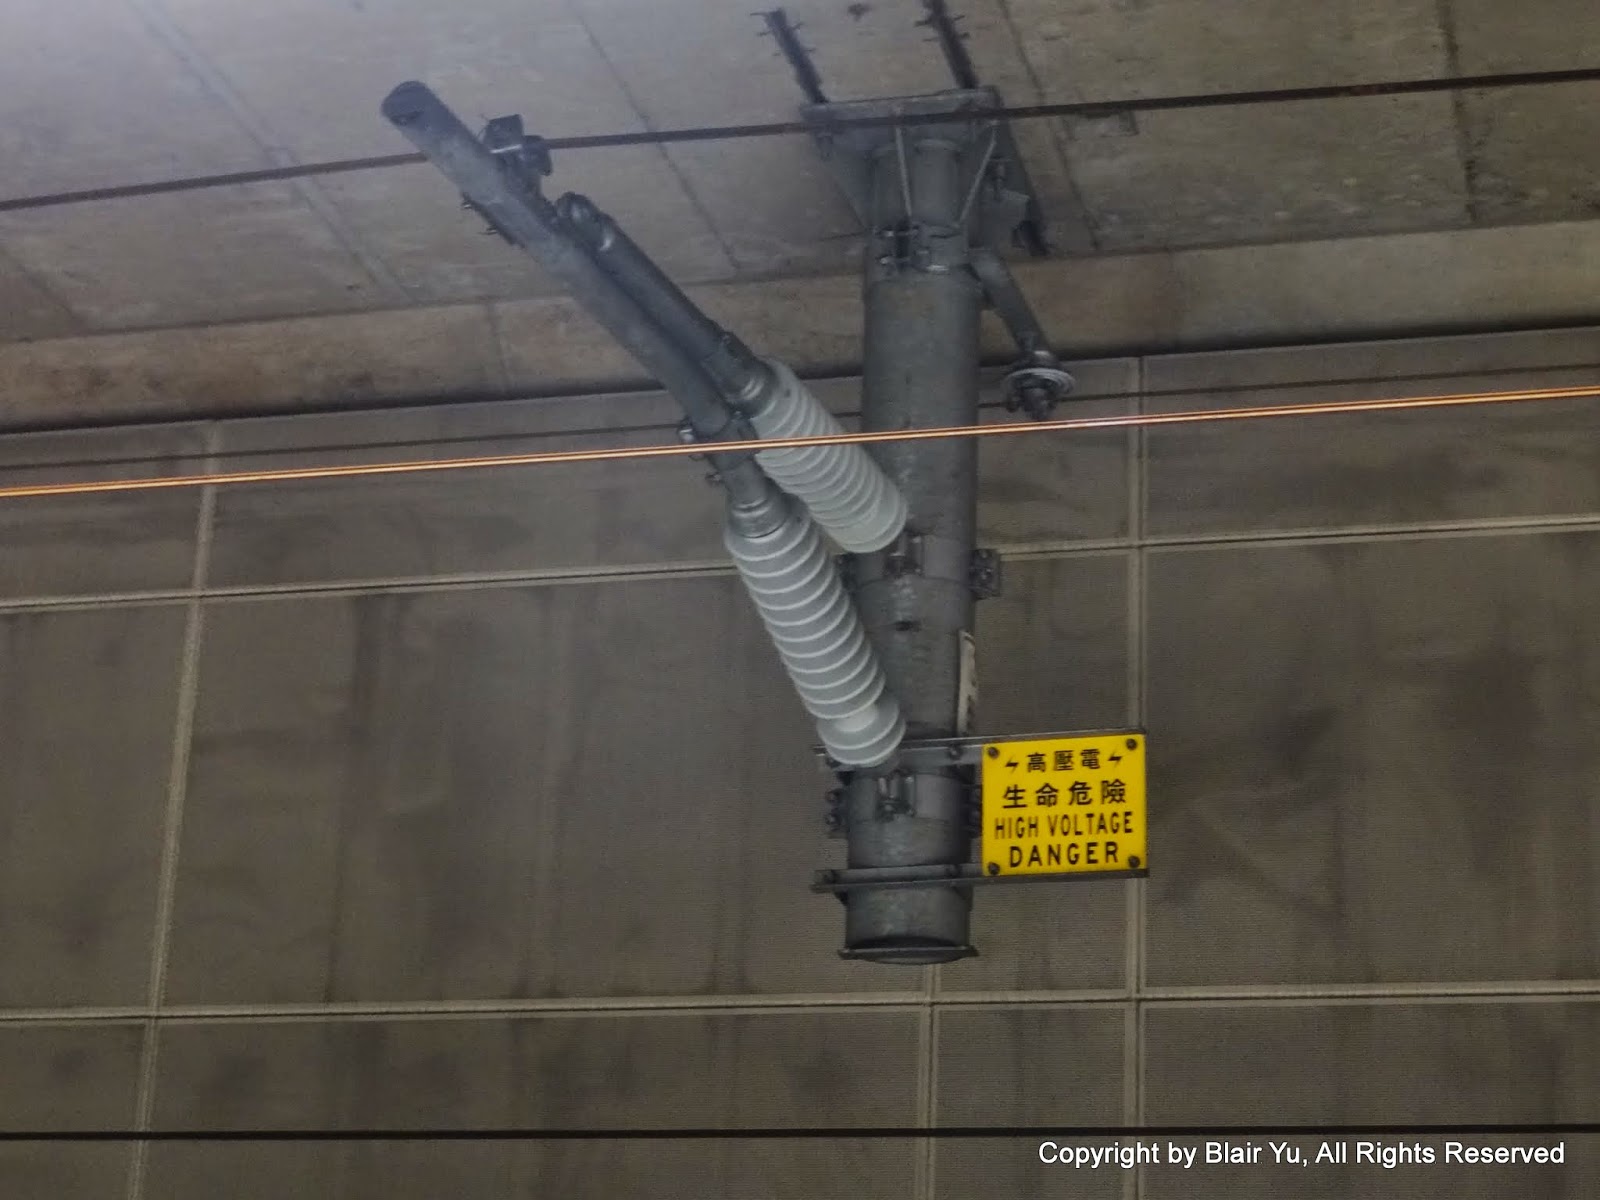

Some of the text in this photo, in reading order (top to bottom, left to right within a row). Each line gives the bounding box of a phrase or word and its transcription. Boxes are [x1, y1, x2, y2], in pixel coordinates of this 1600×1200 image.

[1027, 749, 1101, 773] 高壓電
[1002, 778, 1126, 809] 生命危險
[994, 811, 1134, 840] HIGH VOLTAGE
[1009, 841, 1119, 868] DANGER
